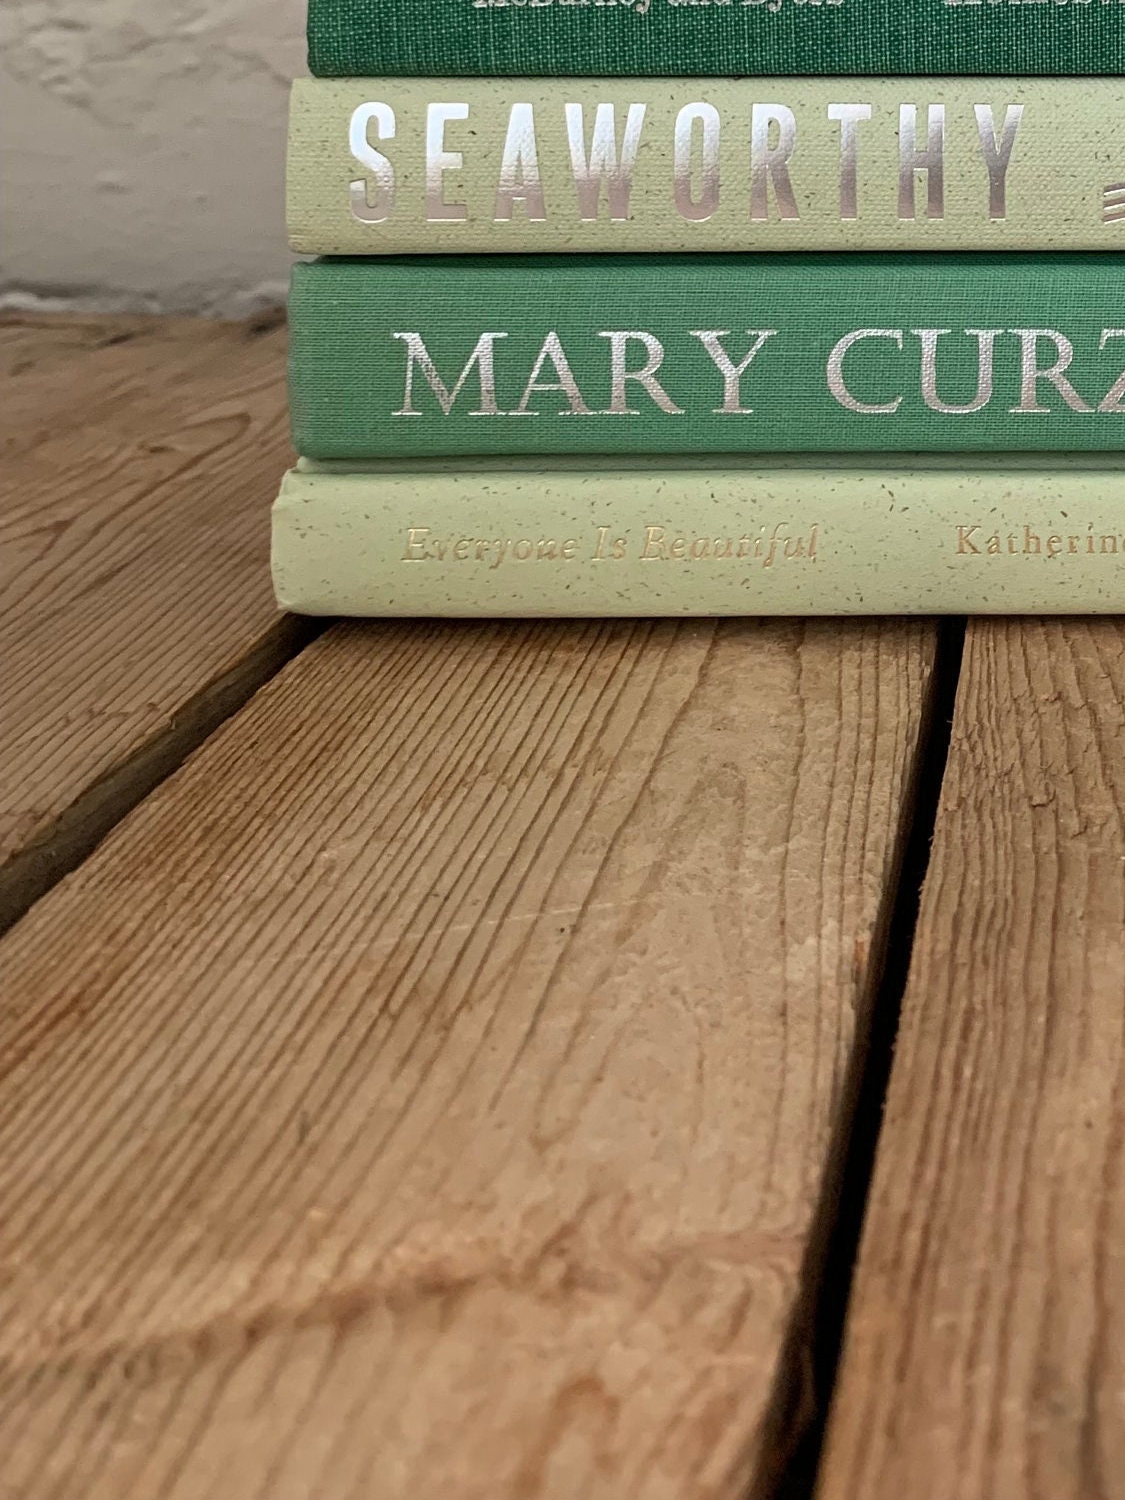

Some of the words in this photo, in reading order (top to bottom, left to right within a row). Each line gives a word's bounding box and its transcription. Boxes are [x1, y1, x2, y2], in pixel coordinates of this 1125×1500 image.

[349, 101, 1025, 223] SEAWORTHY
[391, 331, 777, 417] MARY
[401, 526, 577, 570] Everyone
[590, 525, 627, 562] Is
[640, 523, 818, 569] Beautiful
